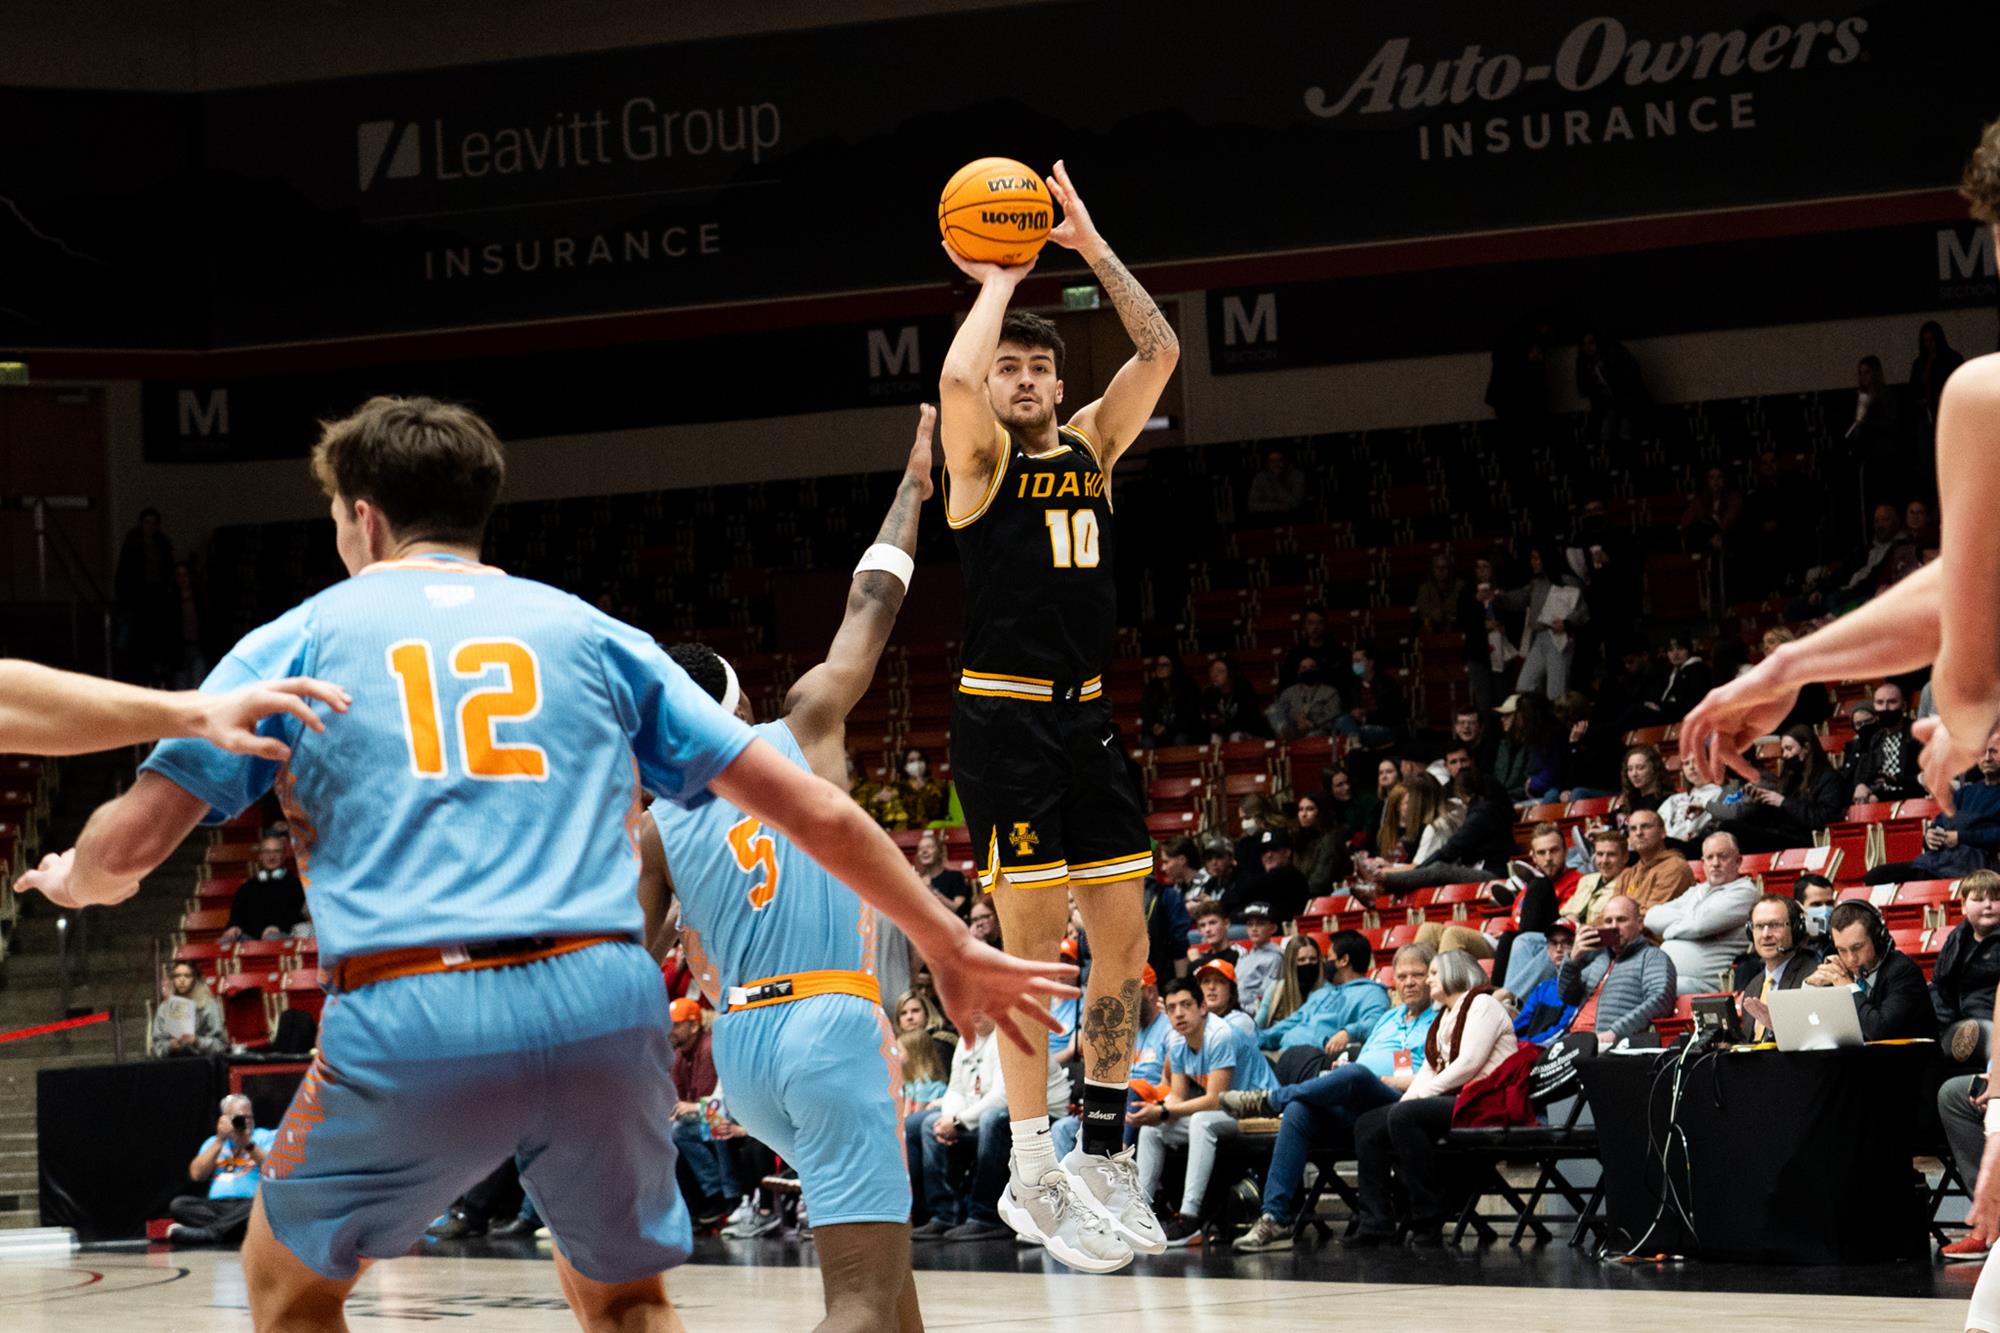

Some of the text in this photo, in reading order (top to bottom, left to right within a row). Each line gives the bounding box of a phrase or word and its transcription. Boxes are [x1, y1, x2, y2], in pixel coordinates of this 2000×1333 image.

[1302, 15, 1870, 119] Auto-Owners
[433, 96, 782, 181] Leavitt Group
[1417, 91, 1758, 161] INSURANCE
[987, 176, 1039, 193] NCAA
[981, 210, 1049, 231] Wilson
[423, 222, 722, 280] INSURANCE
[1936, 225, 1996, 281] M
[1222, 291, 1279, 347] M
[866, 325, 921, 379] M
[177, 387, 231, 437] M
[1017, 470, 1105, 499] IDAHO
[1043, 507, 1101, 569] 10
[384, 636, 551, 783] 12
[726, 815, 780, 912] 5
